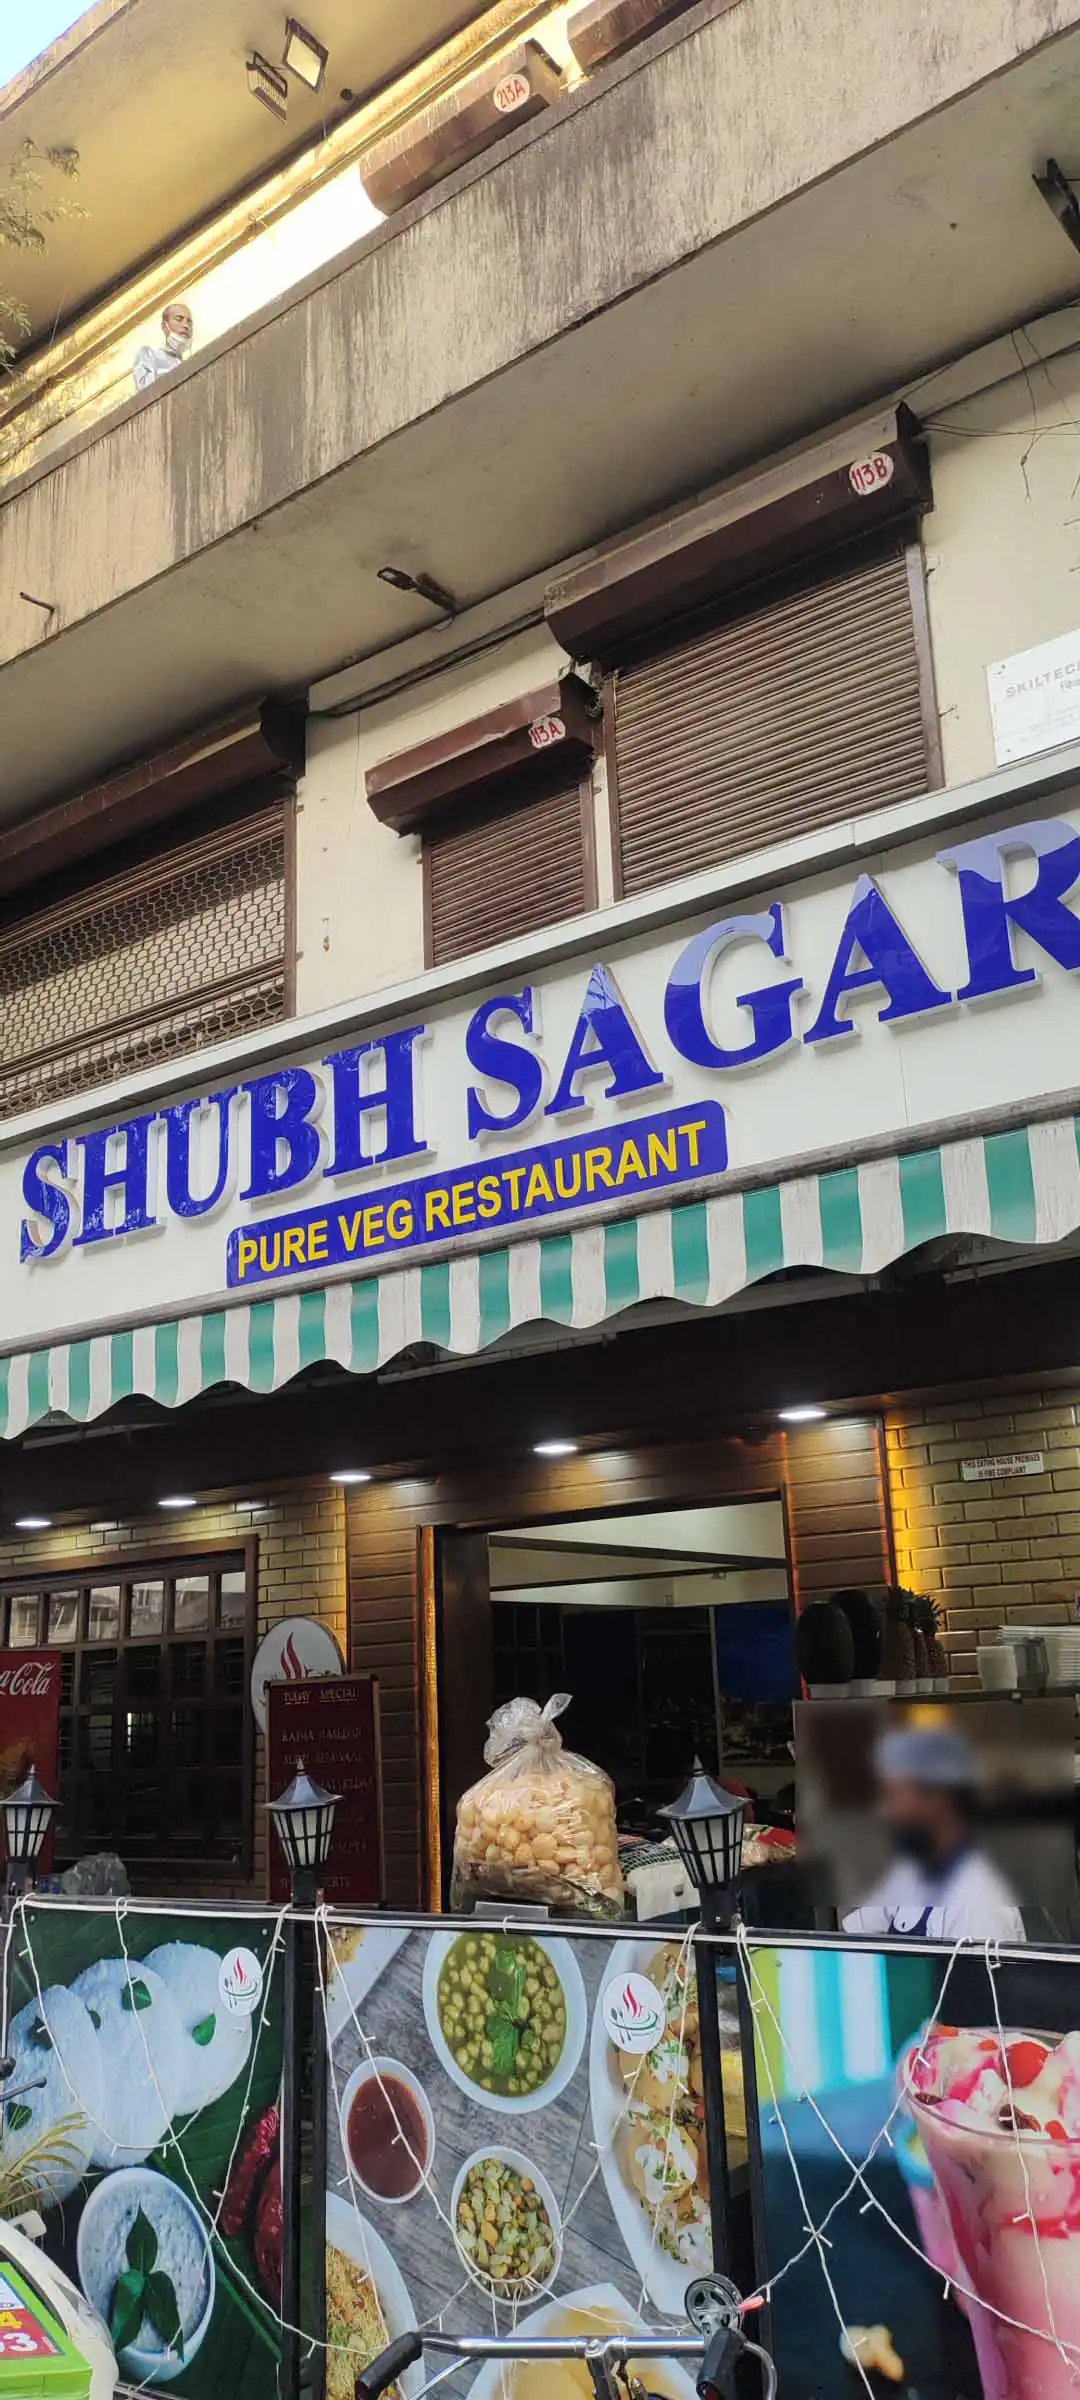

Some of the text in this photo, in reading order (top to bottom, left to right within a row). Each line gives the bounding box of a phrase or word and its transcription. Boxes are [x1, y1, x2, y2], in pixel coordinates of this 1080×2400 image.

[497, 79, 527, 108] 213A
[851, 457, 888, 490] 113B
[1005, 659, 1080, 698] SKILTEC
[530, 721, 563, 744] 113A
[19, 819, 1080, 1265] SHUBH SAGAR
[238, 1120, 707, 1279] PURE VEG RESTAURANT
[963, 1460, 976, 1469] THIS
